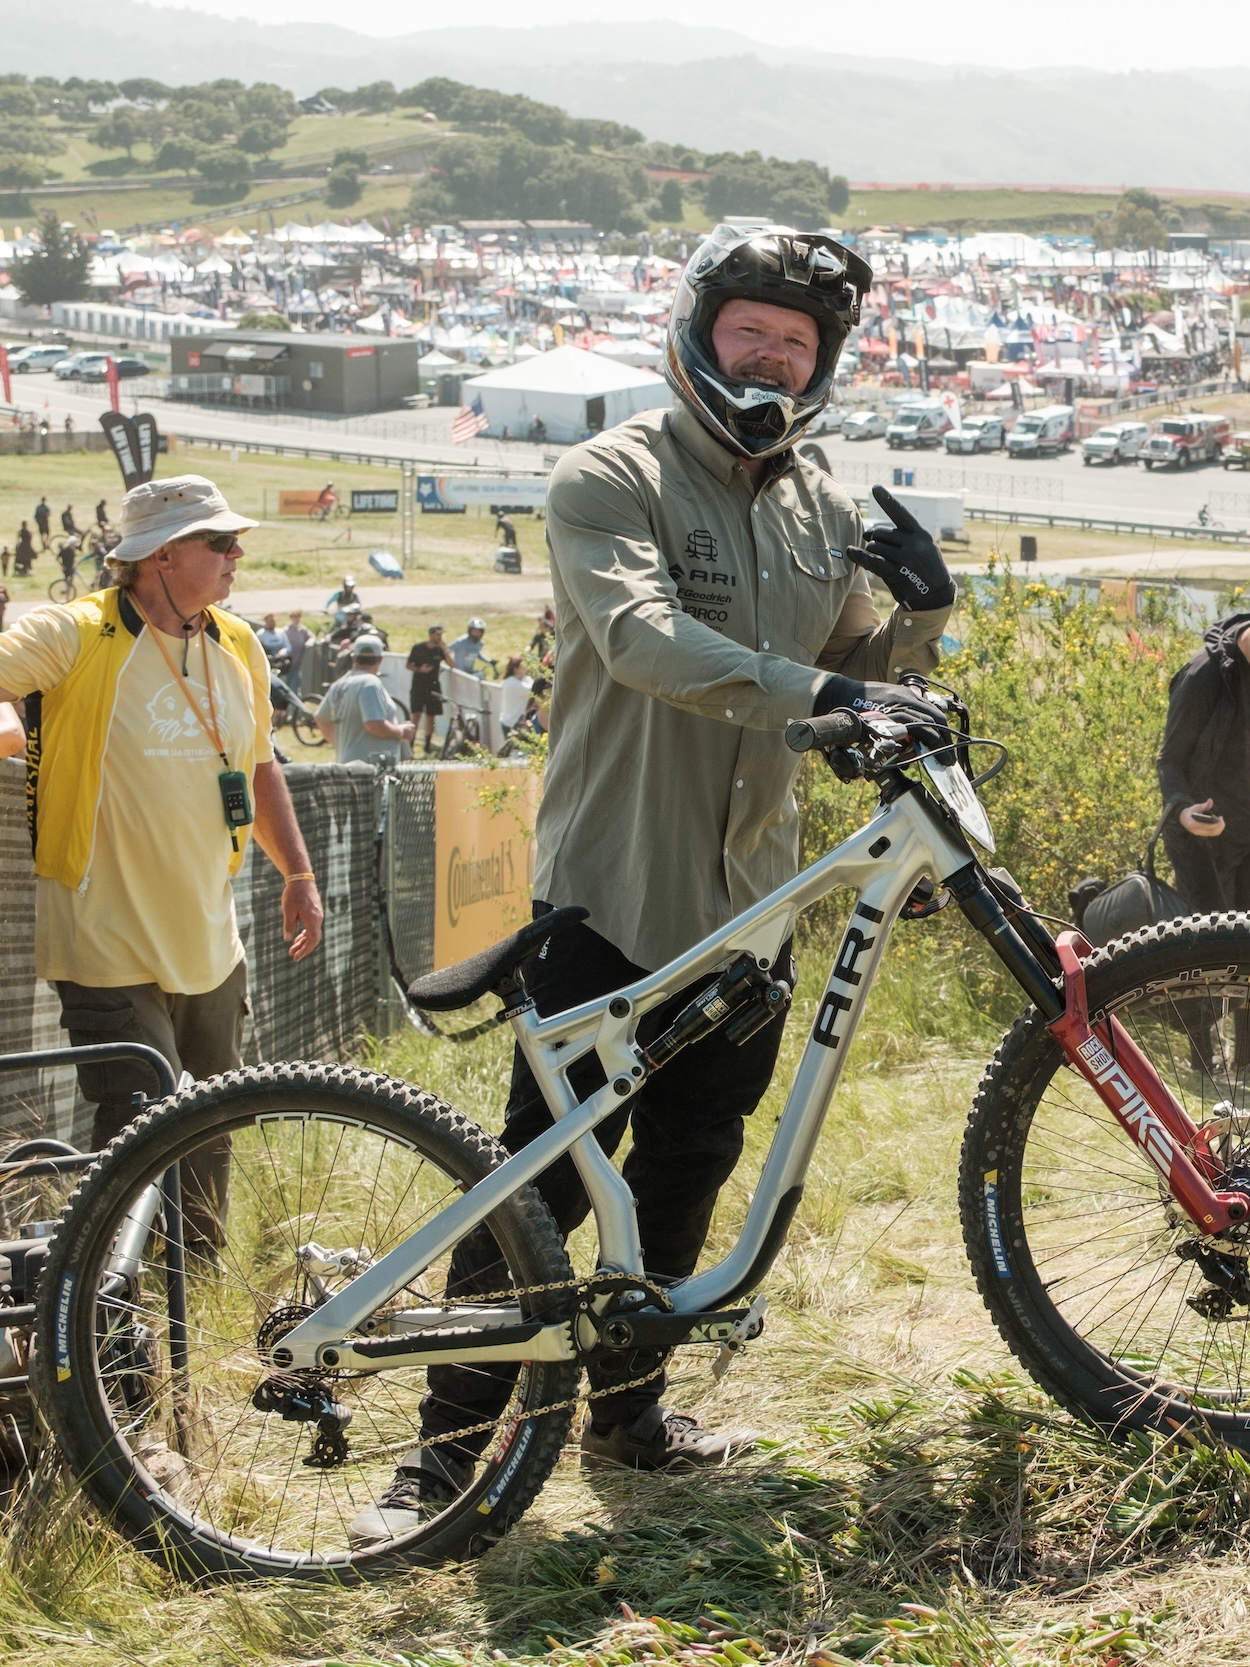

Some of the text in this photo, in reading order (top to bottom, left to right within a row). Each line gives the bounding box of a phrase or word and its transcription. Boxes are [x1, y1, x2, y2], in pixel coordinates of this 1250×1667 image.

[677, 588, 732, 603] FGoodrich
[690, 569, 736, 586] ARI
[813, 901, 885, 1049] ARI
[1081, 1039, 1103, 1059] ROCK
[1091, 1049, 1111, 1071] SHOX
[1096, 1062, 1175, 1178] PIKE
[69, 1221, 92, 1265] WILD
[986, 1198, 1008, 1272] MICHELIN
[58, 1278, 73, 1353] MICHELIN
[1007, 1285, 1031, 1329] WILD
[495, 1402, 524, 1463] STAS
[495, 1425, 533, 1494] MICHELIN
